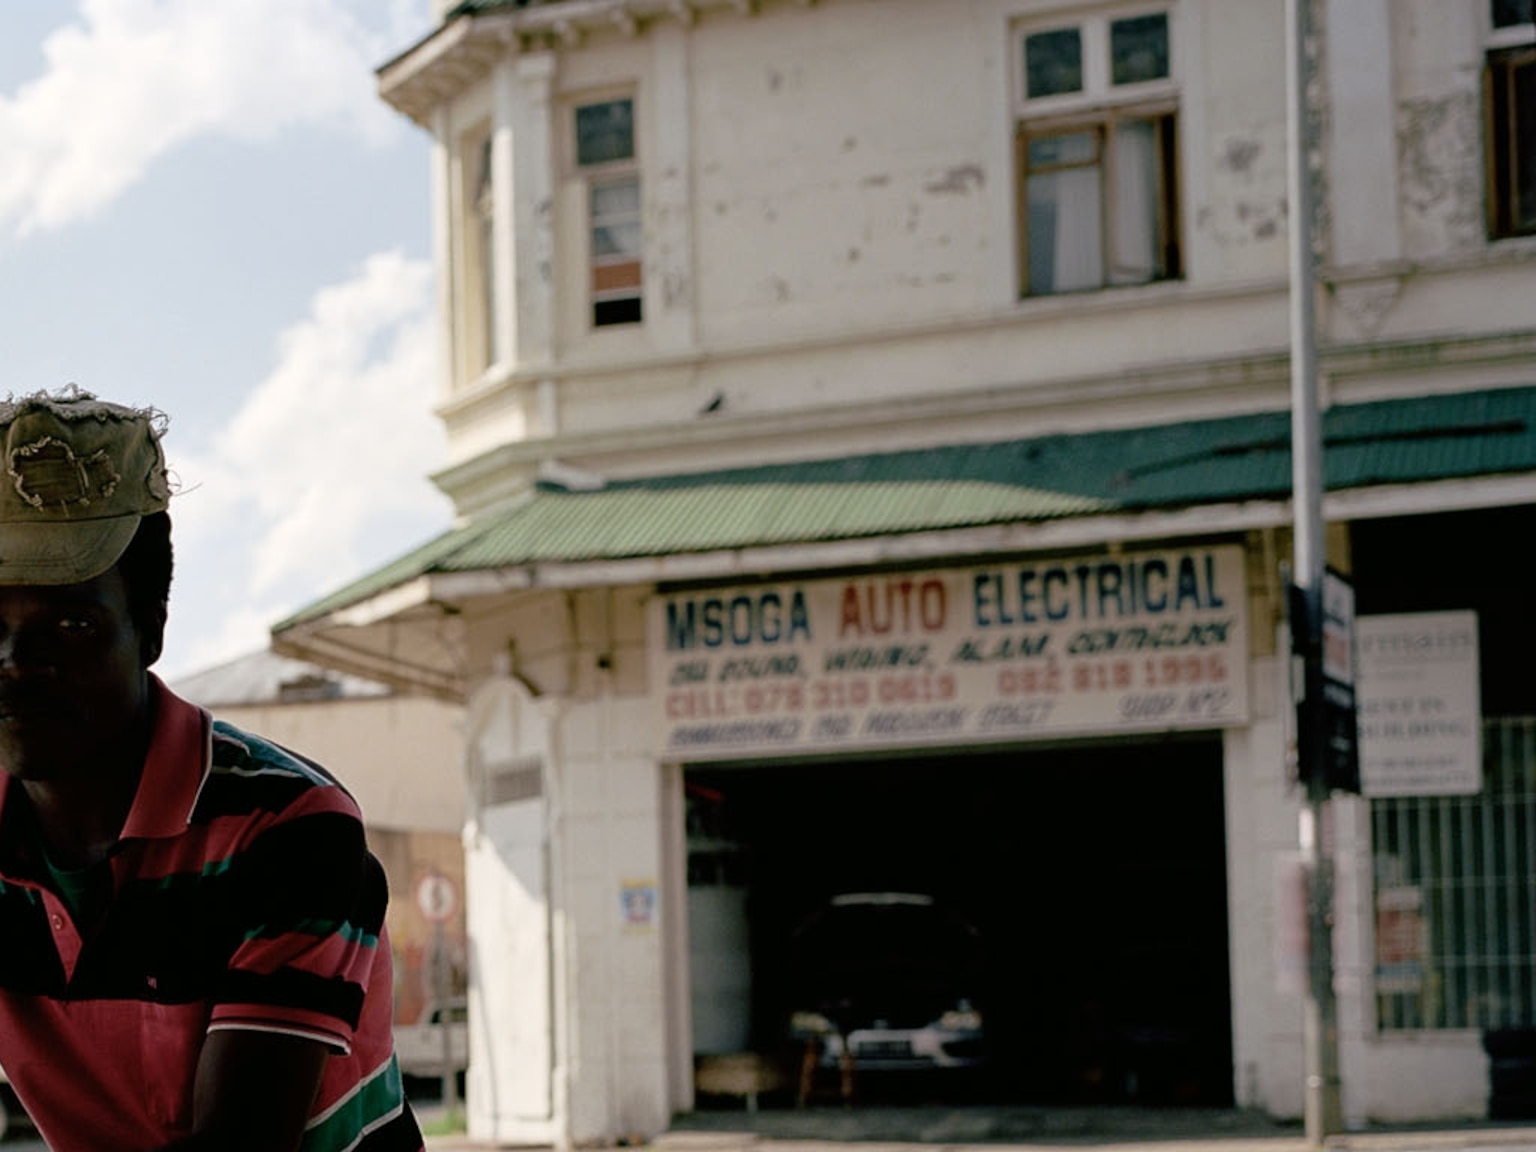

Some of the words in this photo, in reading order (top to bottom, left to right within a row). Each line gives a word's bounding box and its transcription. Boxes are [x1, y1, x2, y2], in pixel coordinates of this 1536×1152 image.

[666, 588, 811, 650] MSOGA
[839, 579, 946, 637] AUTO
[973, 554, 1224, 627] ELECTRICAL
